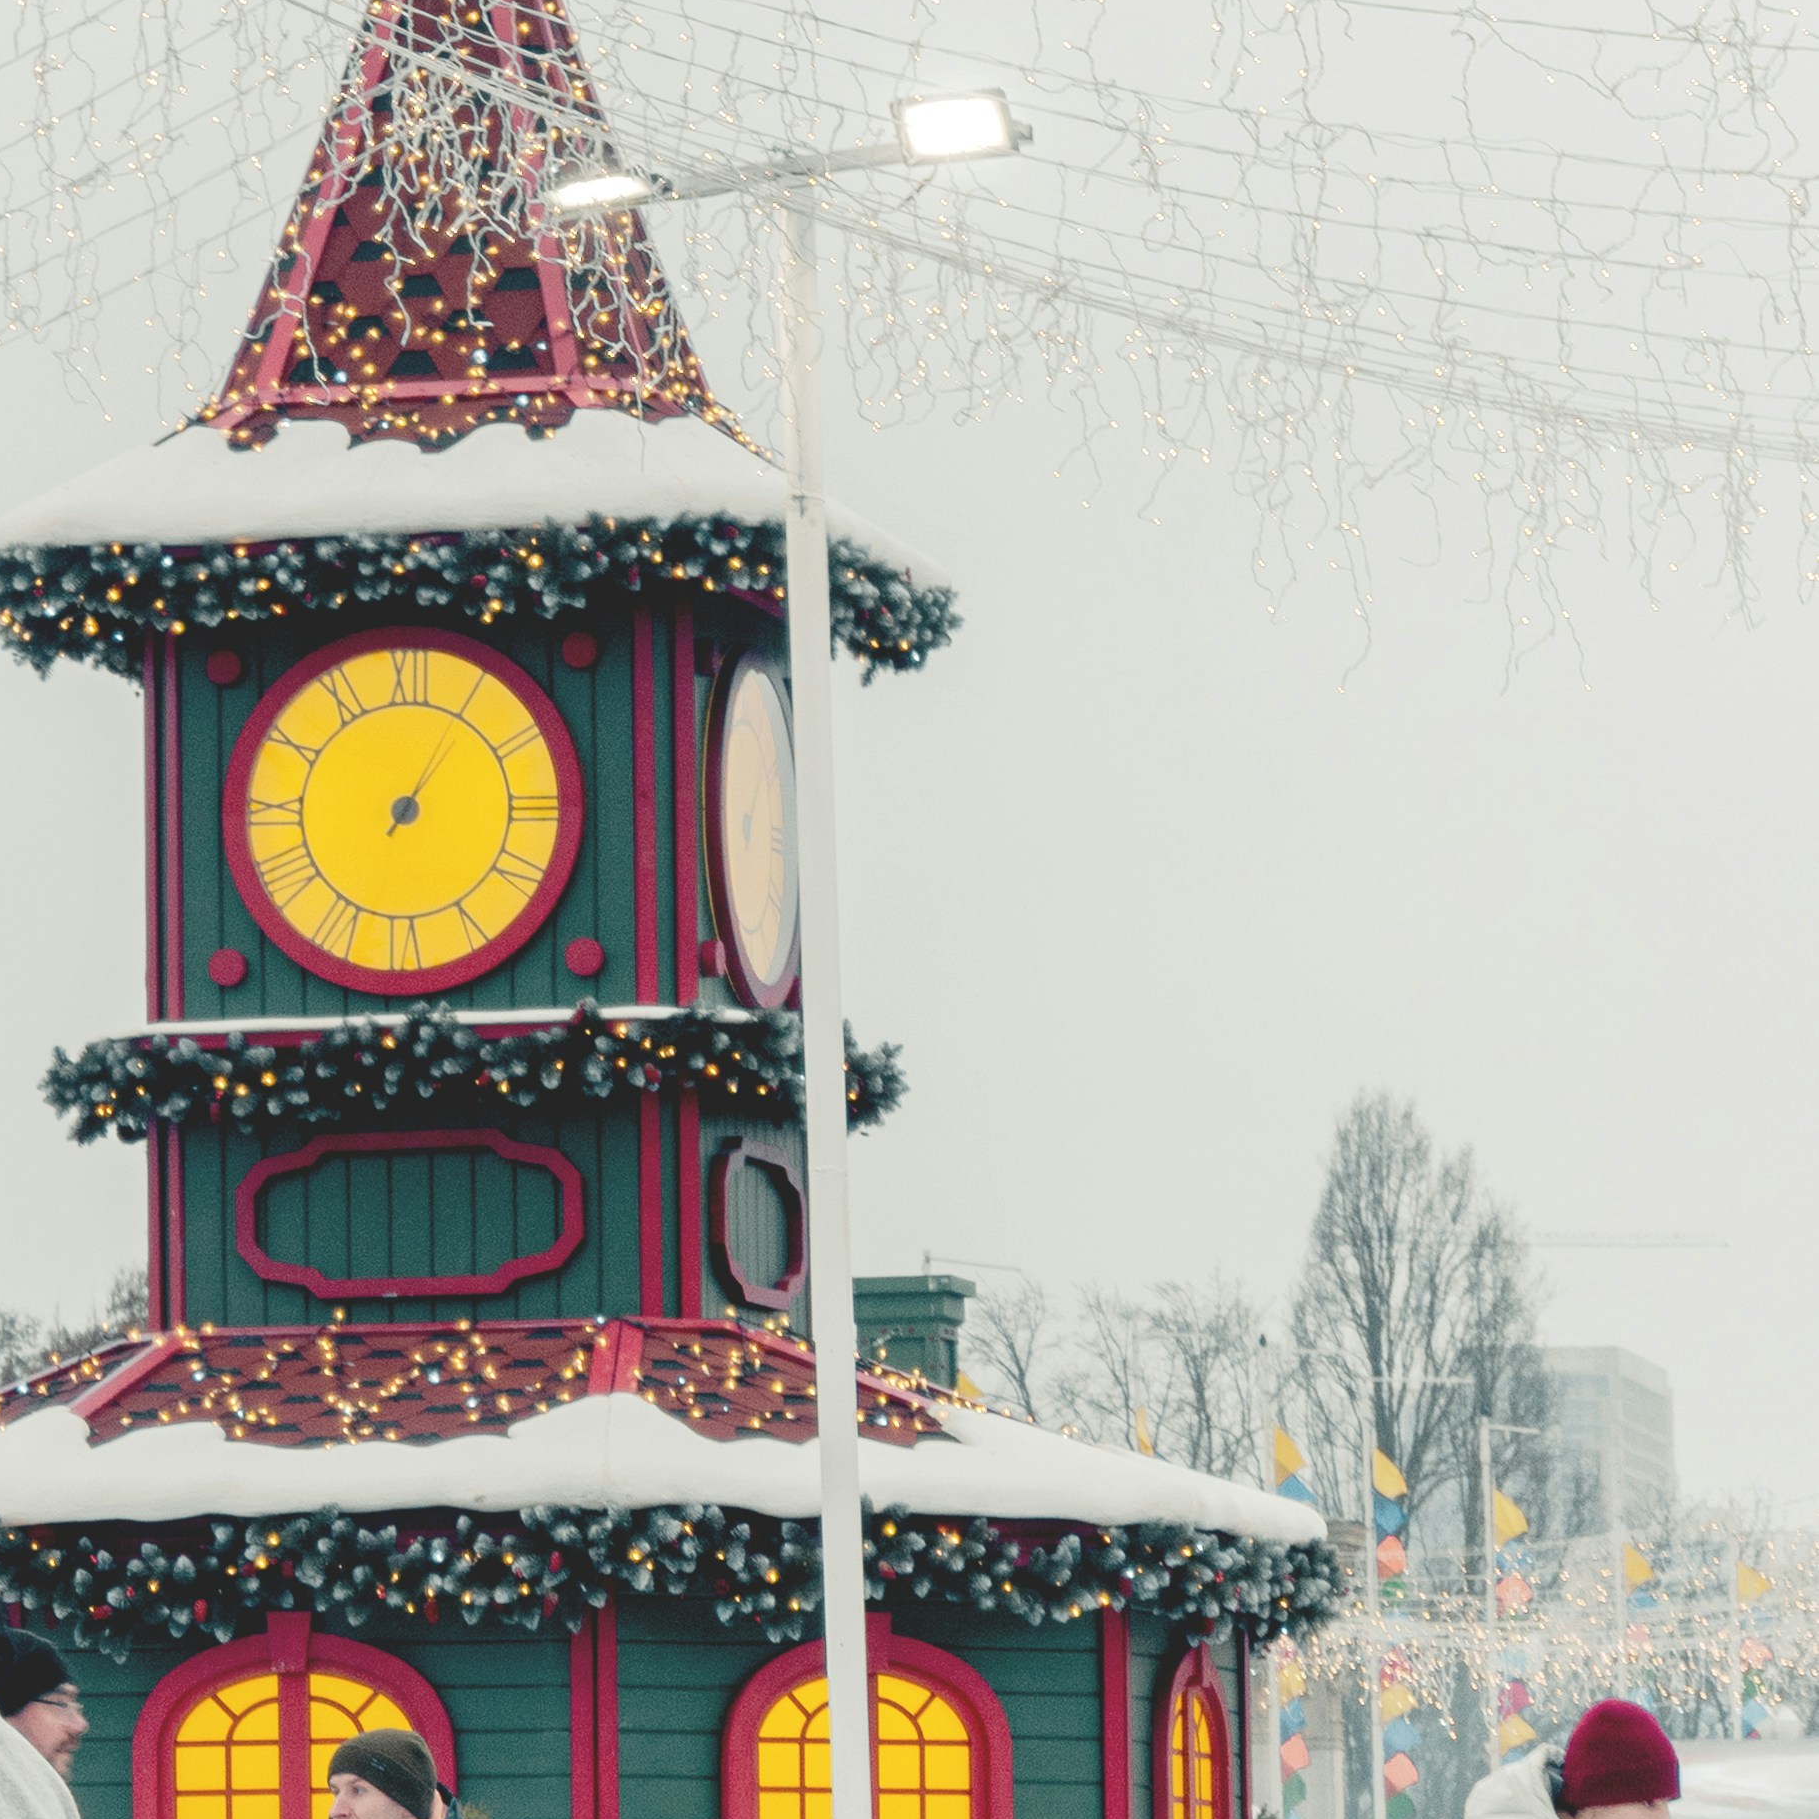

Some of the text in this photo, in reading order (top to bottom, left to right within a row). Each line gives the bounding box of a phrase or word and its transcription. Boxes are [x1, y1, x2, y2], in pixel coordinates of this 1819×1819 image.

[317, 669, 368, 727] XI
[389, 649, 429, 707] XII
[456, 671, 487, 718] I
[267, 724, 321, 766] X
[496, 724, 543, 760] II
[249, 797, 303, 826] IX
[509, 795, 559, 822] III
[257, 843, 318, 910] VIII
[492, 850, 546, 900] IV
[311, 893, 363, 961] VII
[389, 917, 423, 971] VI
[456, 901, 492, 950] V
